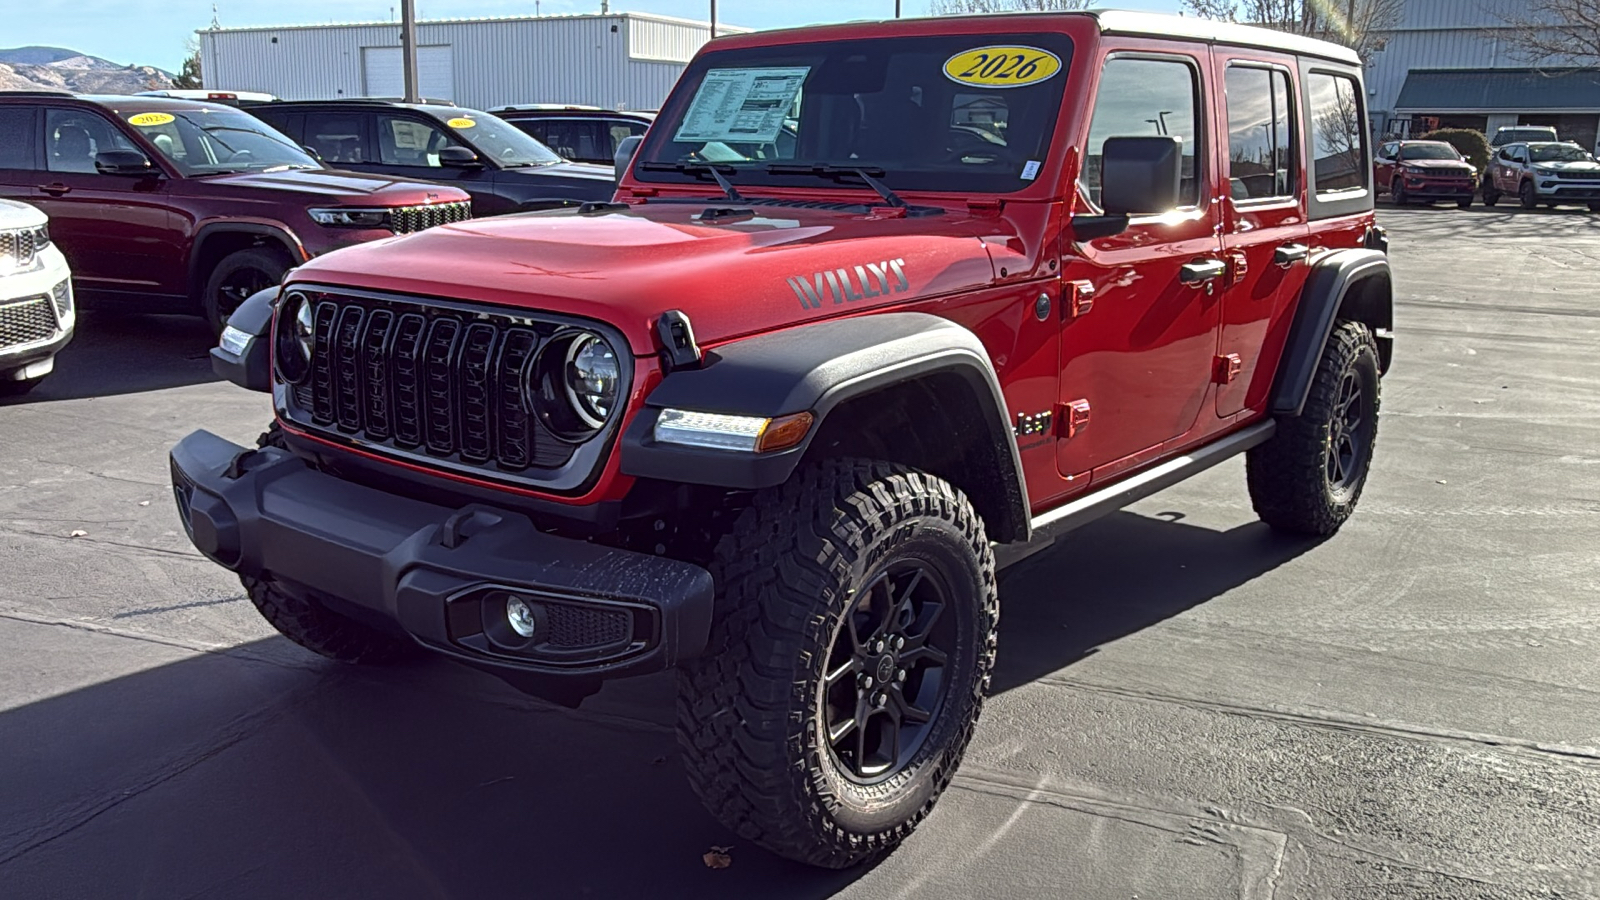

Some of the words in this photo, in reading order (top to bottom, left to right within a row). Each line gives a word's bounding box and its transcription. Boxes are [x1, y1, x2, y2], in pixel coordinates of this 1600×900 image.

[958, 53, 1048, 79] 2026
[138, 115, 167, 124] 2025
[786, 258, 910, 310] WILLYS
